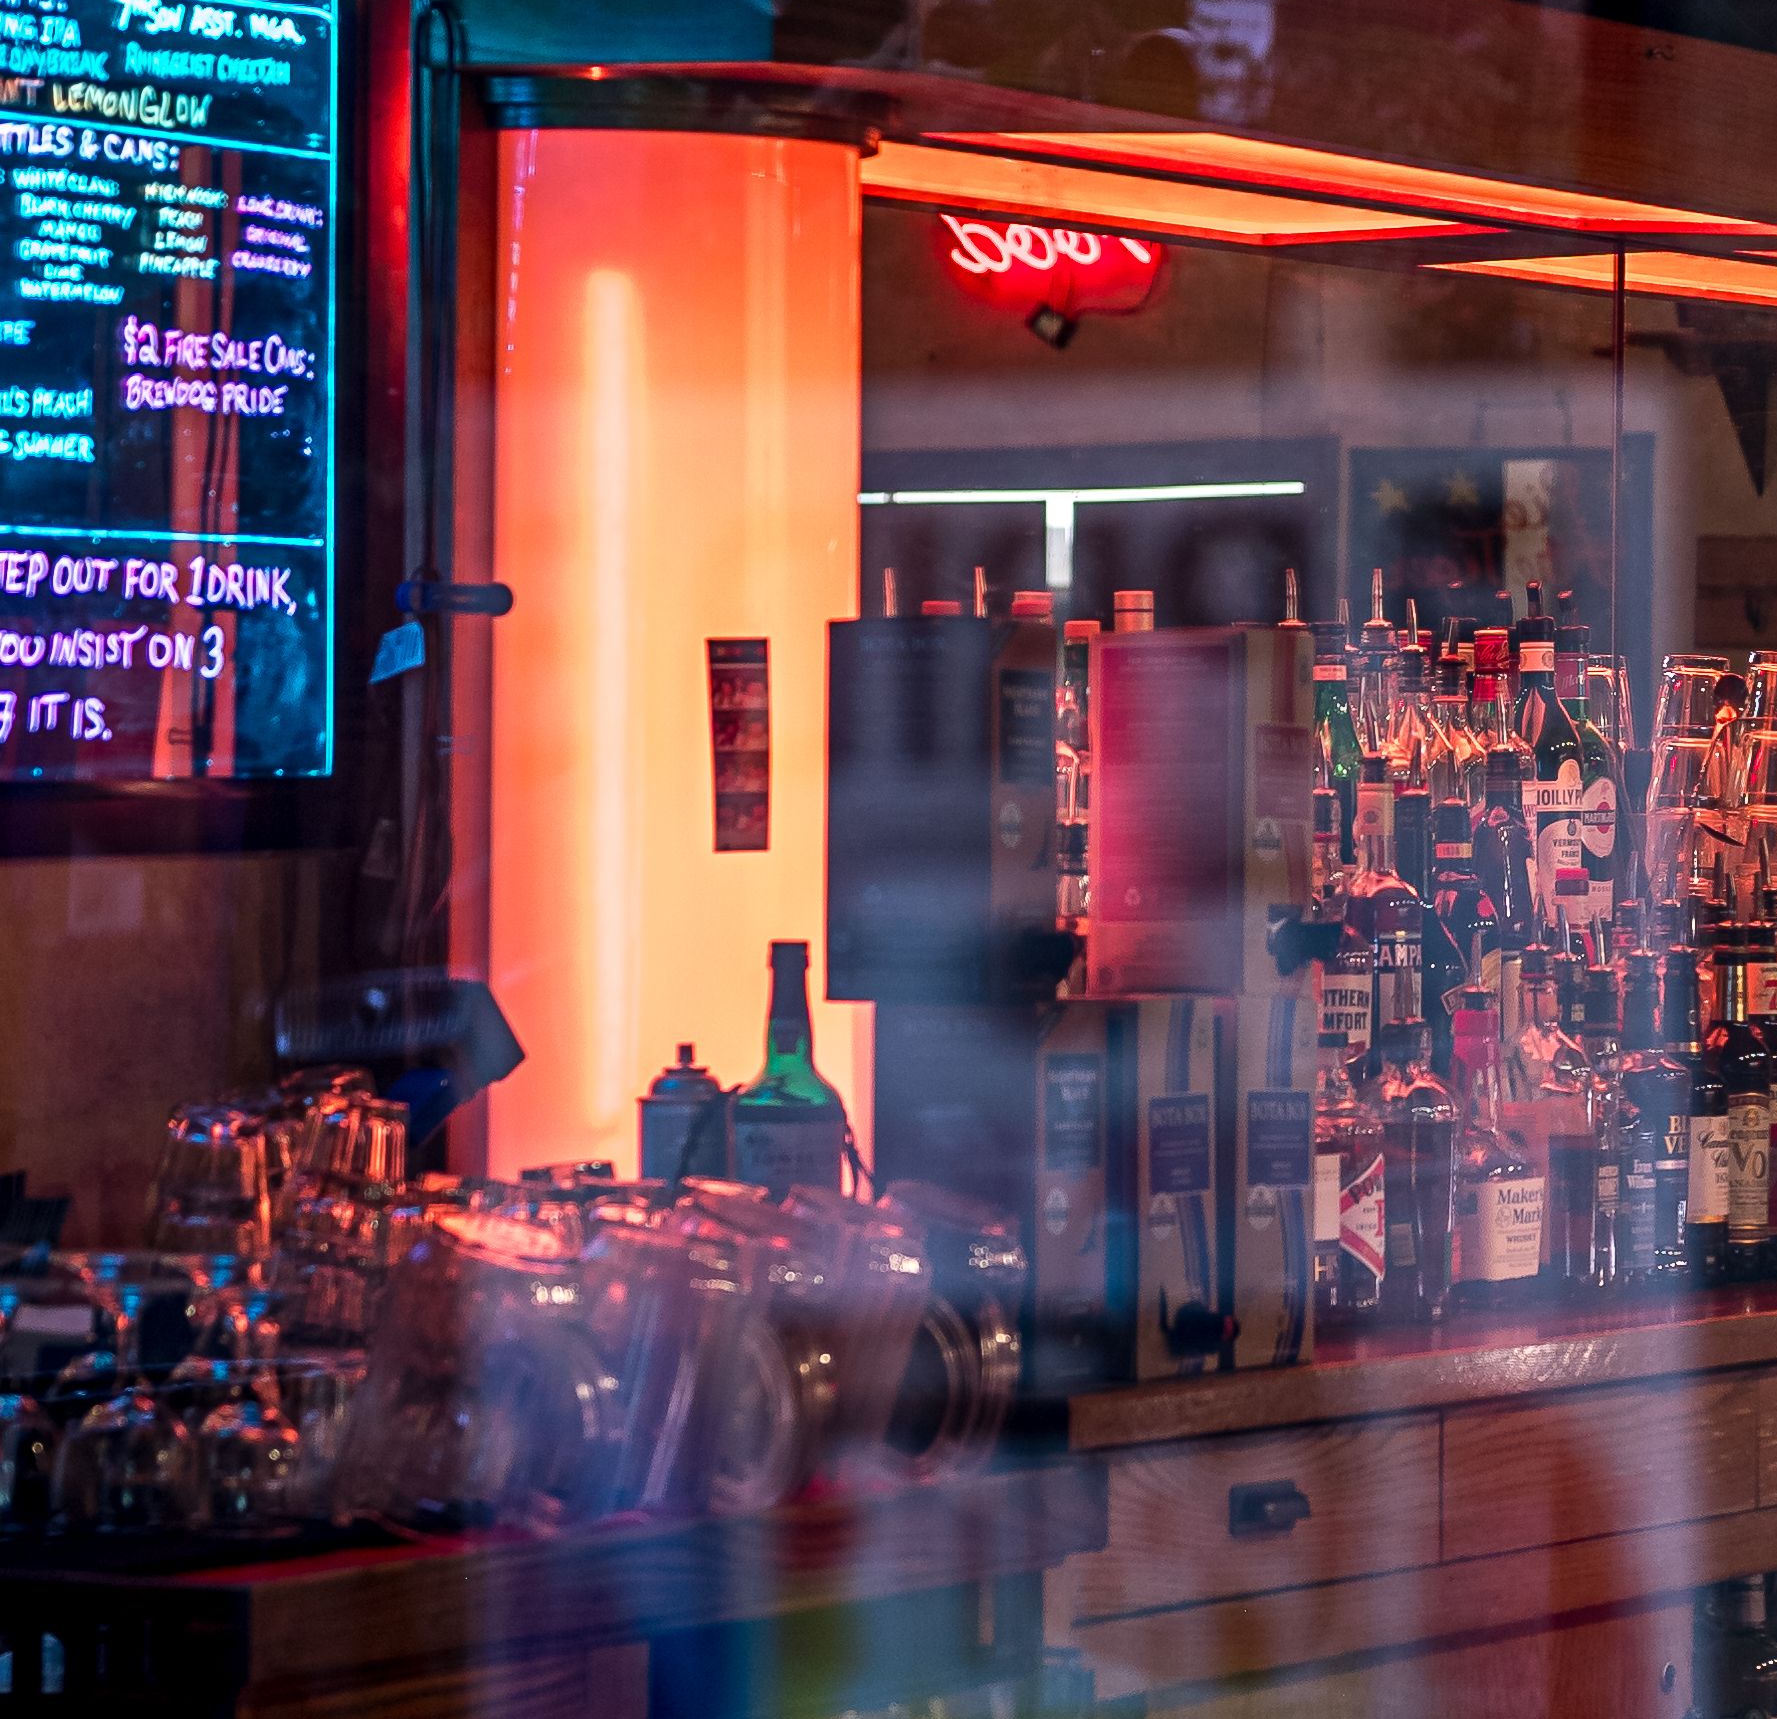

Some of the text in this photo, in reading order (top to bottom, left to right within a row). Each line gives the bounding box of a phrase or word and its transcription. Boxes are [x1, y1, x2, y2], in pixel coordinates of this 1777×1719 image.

[79, 129, 99, 161] &
[138, 251, 221, 281] PINEAPPLE
[122, 314, 160, 367] $2
[163, 330, 211, 371] FIRE
[211, 332, 263, 373] SALE
[32, 387, 93, 419] PEACH
[125, 373, 289, 415] BREWDOG PRIDE
[13, 430, 95, 463] SUMMER
[52, 555, 119, 596] OUT
[124, 558, 180, 605] FOR
[50, 626, 149, 670] INSIST
[149, 632, 195, 670] ON
[200, 625, 225, 679] 3
[29, 691, 71, 734] IT
